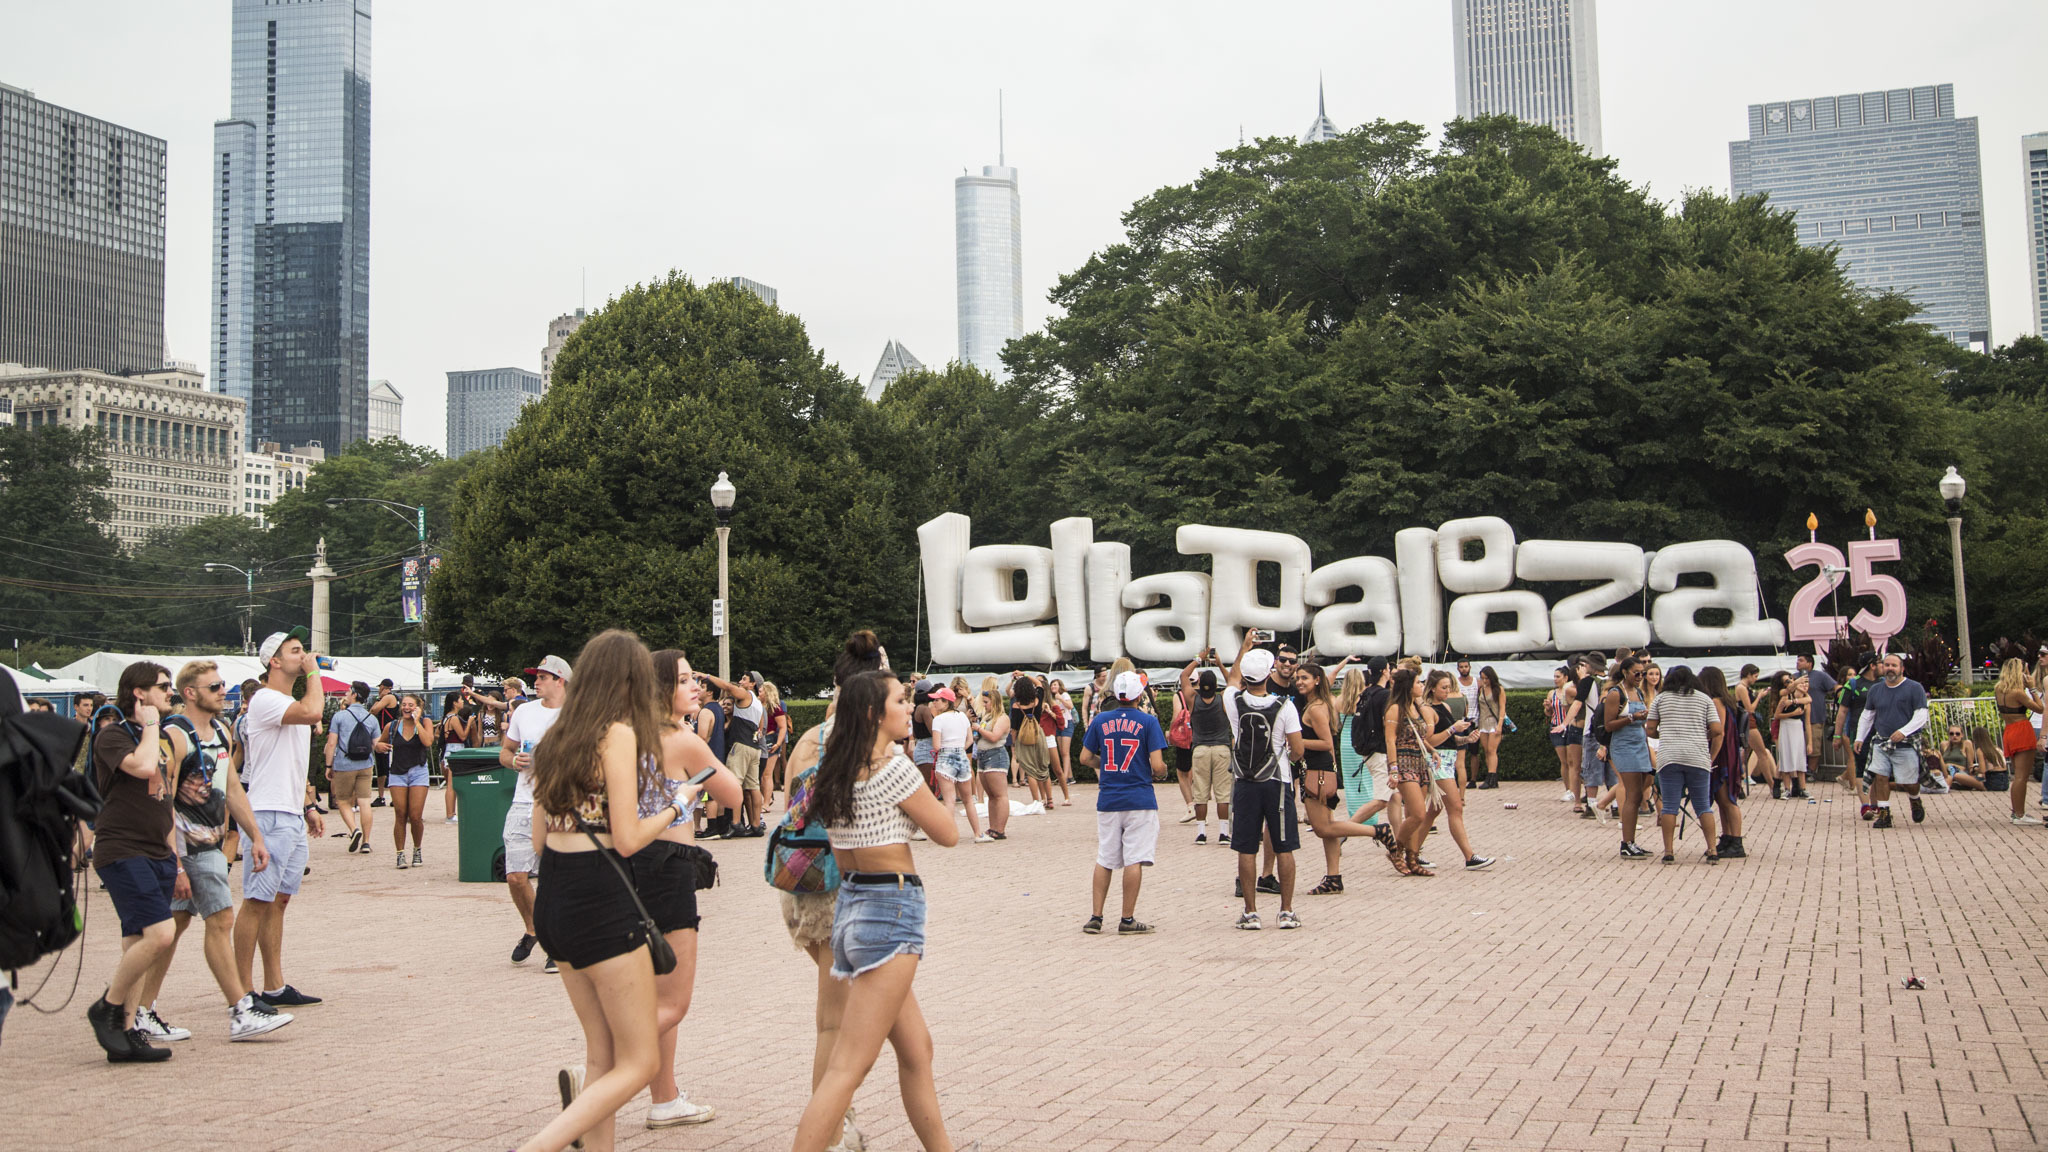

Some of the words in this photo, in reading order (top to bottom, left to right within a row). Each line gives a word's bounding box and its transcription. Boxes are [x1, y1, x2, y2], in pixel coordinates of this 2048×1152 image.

[1784, 538, 1907, 642] 25
[1102, 719, 1143, 736] BRYANT
[1104, 739, 1140, 771] 17
